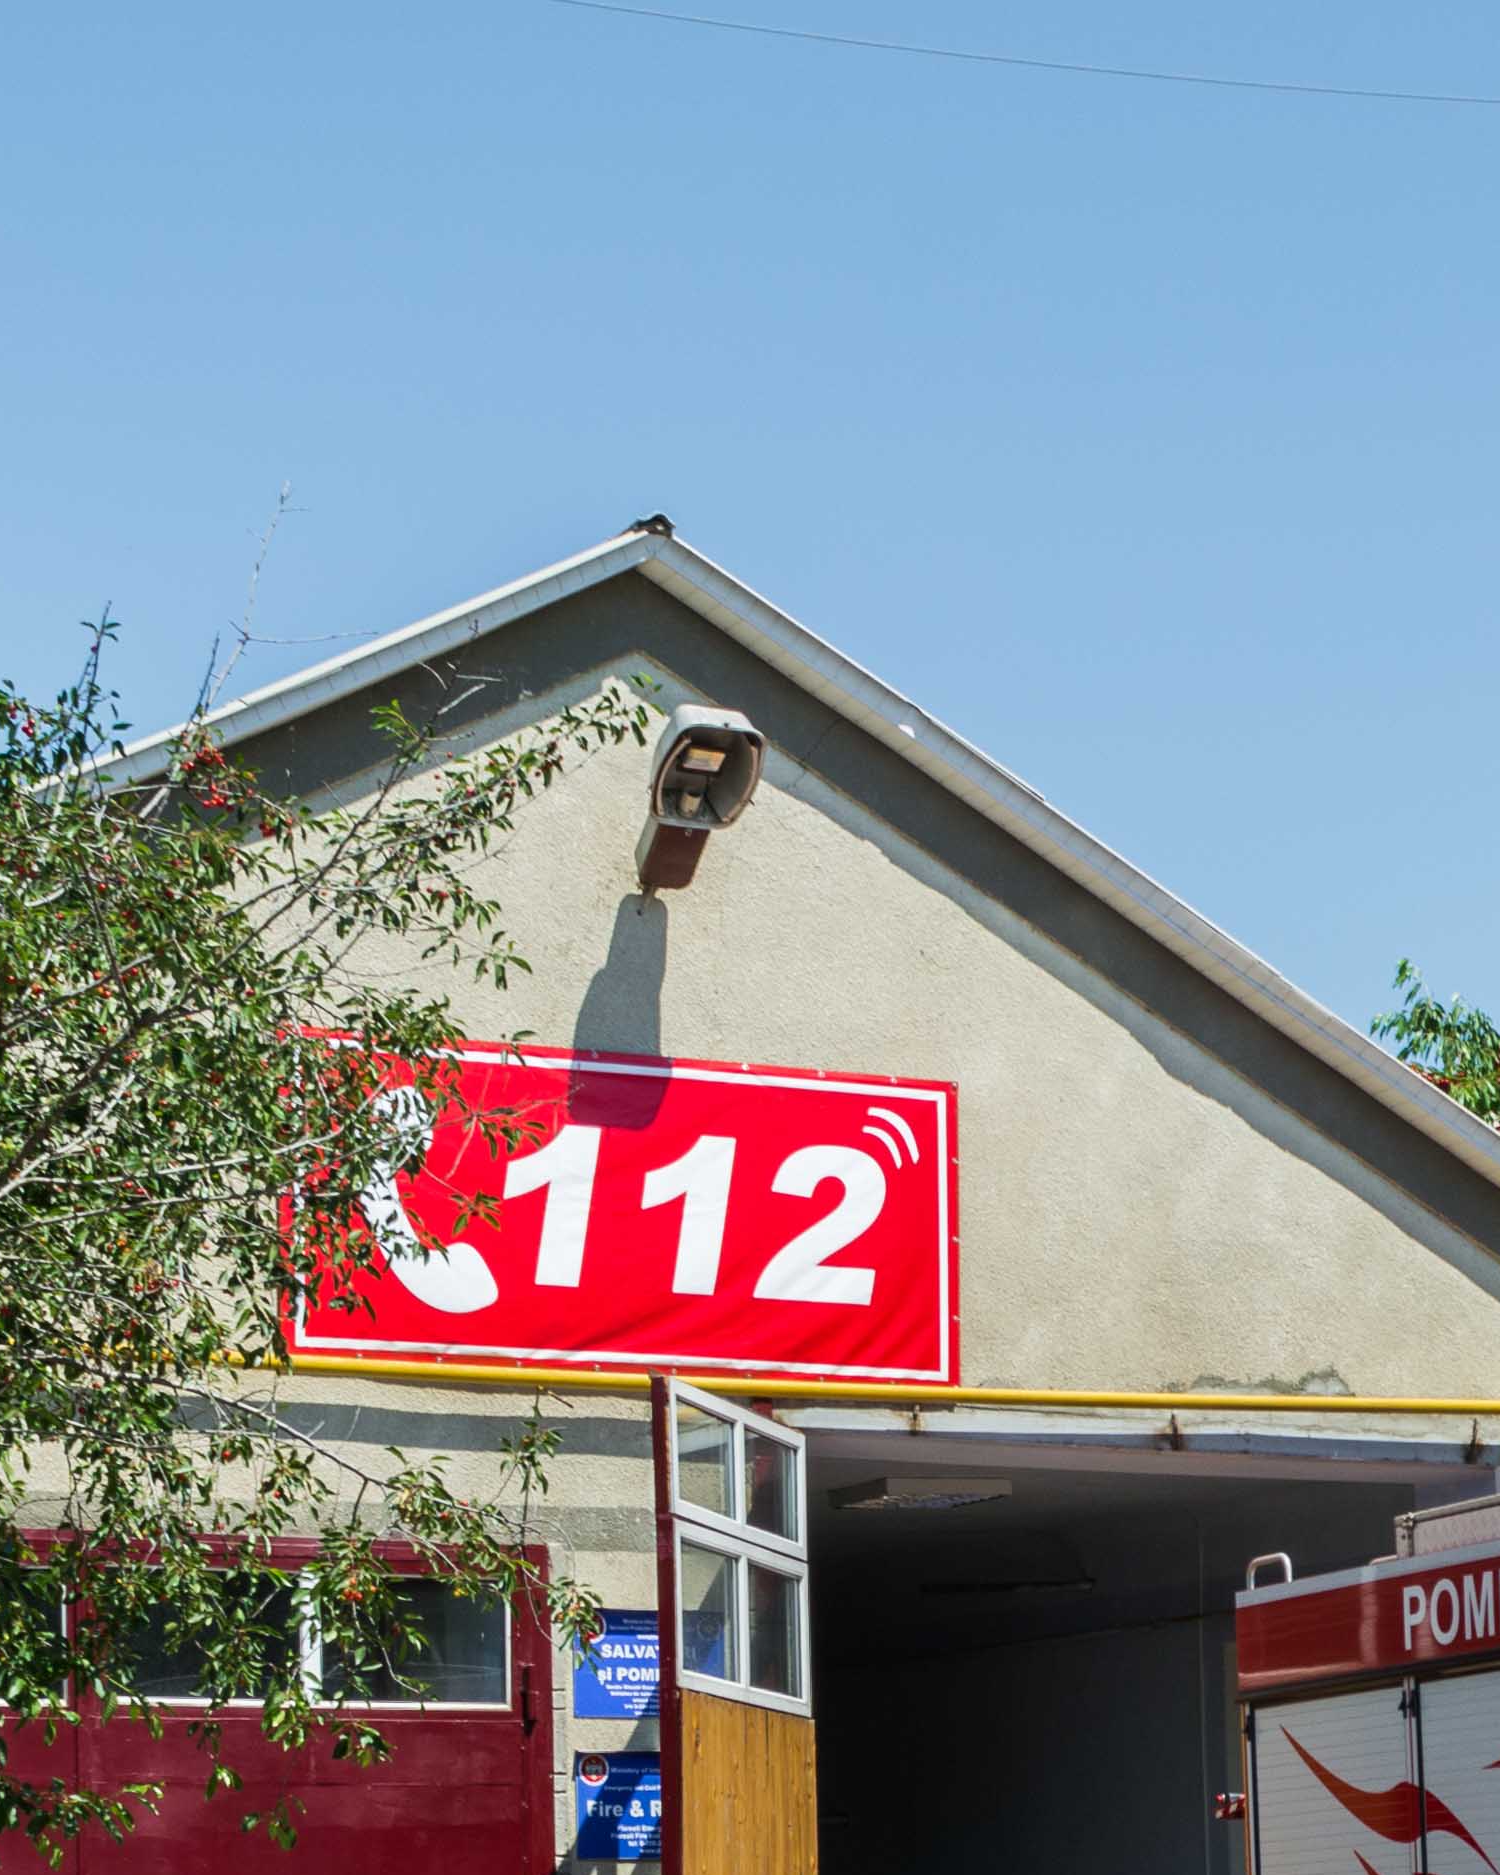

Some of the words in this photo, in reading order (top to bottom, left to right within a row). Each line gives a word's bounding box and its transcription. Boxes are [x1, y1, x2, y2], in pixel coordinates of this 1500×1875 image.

[502, 1124, 887, 1305] 112
[586, 1799, 623, 1817] Fire
[629, 1799, 645, 1818] &
[650, 1799, 662, 1817] R
